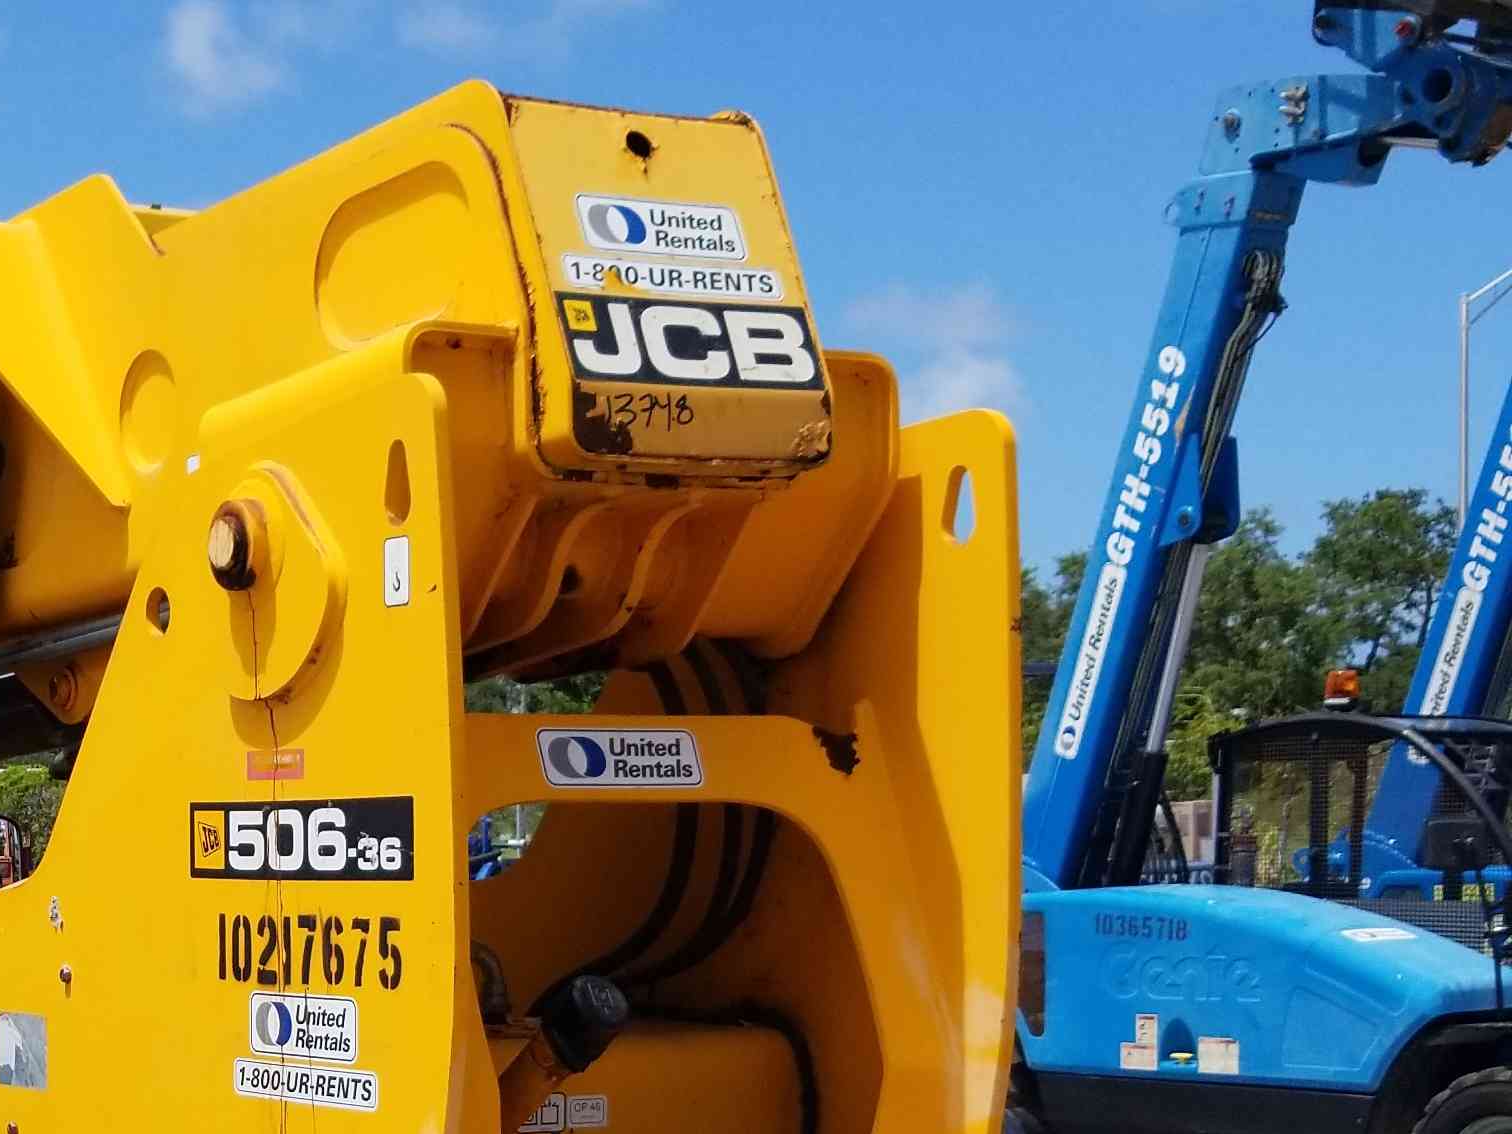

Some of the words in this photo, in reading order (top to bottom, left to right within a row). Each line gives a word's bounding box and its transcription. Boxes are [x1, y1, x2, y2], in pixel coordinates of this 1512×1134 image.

[649, 208, 722, 231] United
[654, 230, 736, 253] Rentals
[572, 302, 816, 382] JCB
[1105, 345, 1186, 567] GTH-5519
[1070, 653, 1097, 722] United
[609, 737, 680, 757] United
[613, 759, 693, 778] Rentals
[1095, 912, 1189, 942] 10365718
[218, 912, 402, 991] 10217675
[294, 1004, 347, 1029] United
[294, 1028, 351, 1053] Rentals
[239, 1066, 373, 1103] 1-800-UR-RENTS
